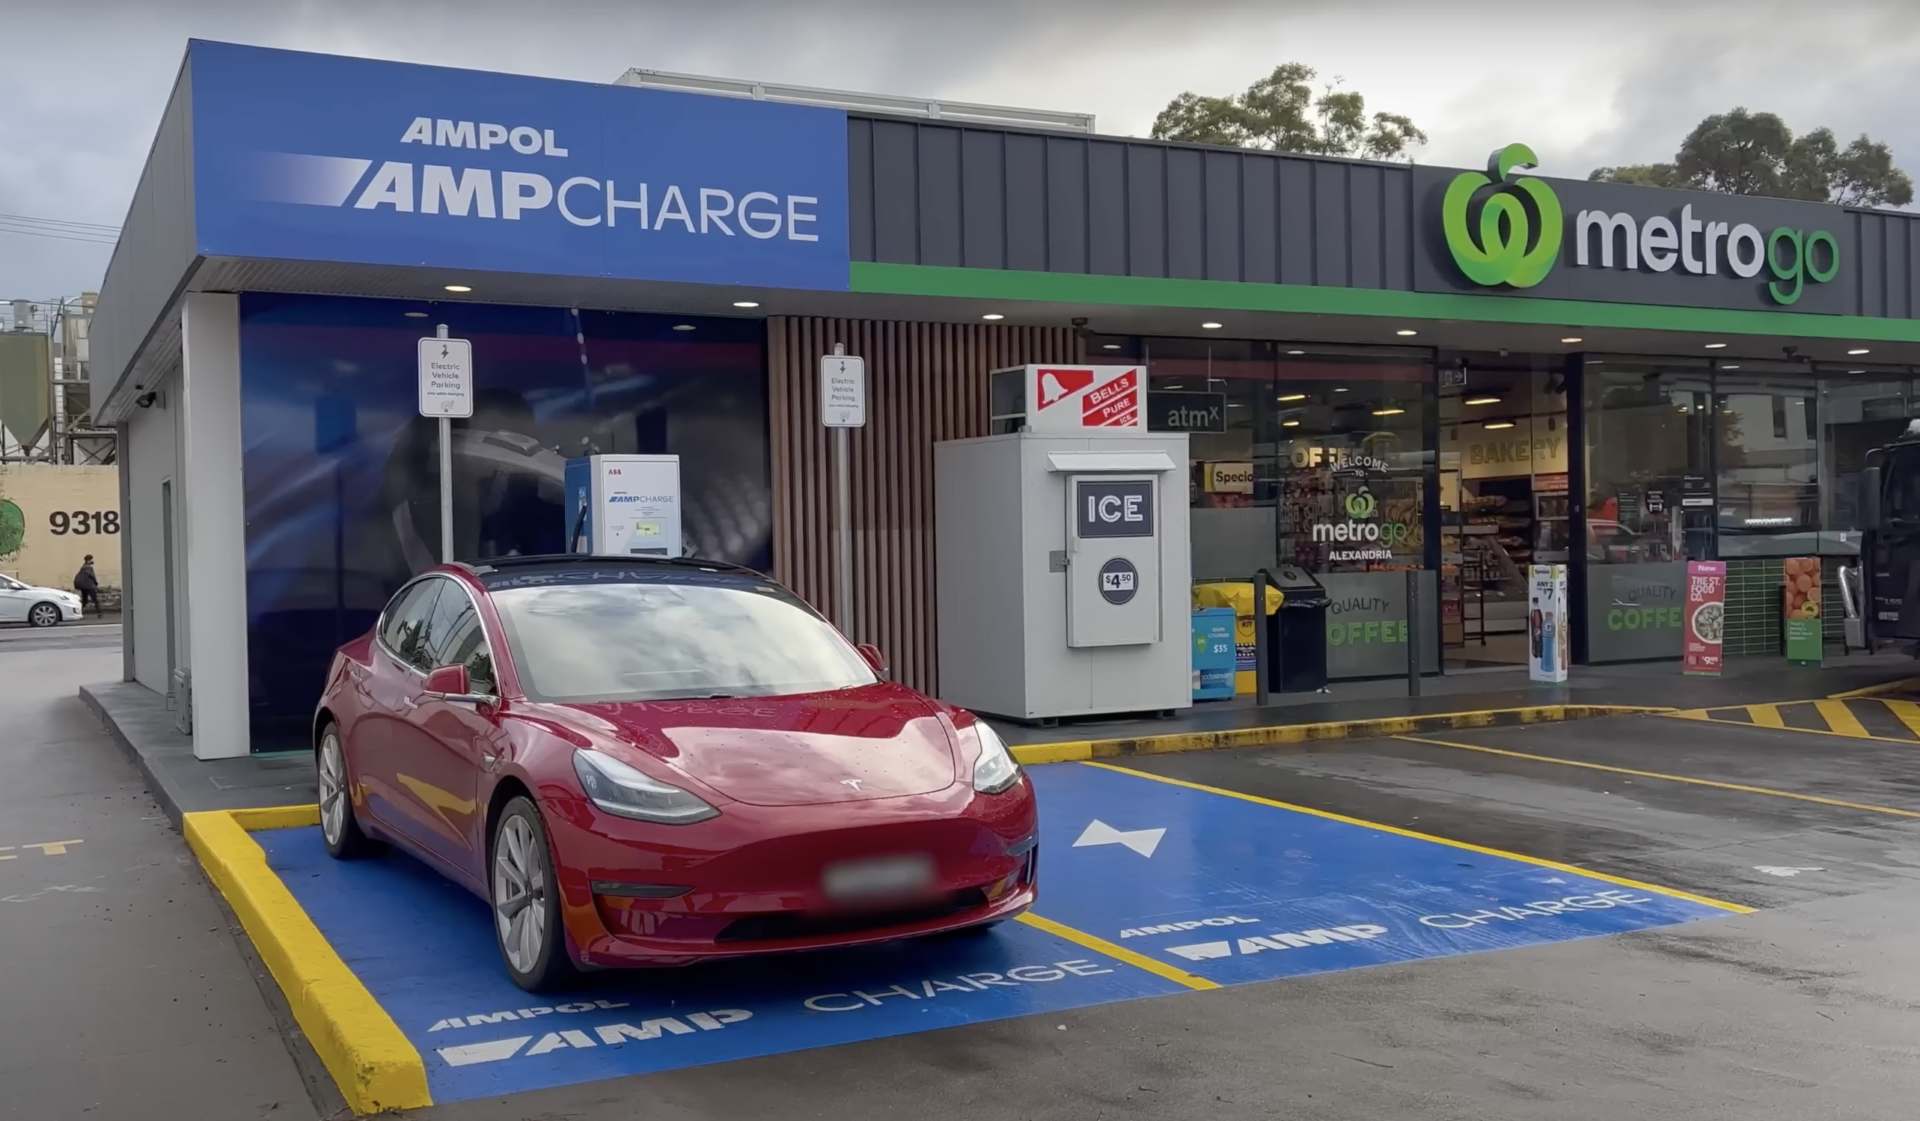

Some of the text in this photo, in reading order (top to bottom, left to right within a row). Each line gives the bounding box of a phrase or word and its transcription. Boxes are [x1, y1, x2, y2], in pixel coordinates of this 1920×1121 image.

[400, 117, 569, 157] AMPOL
[353, 160, 819, 242] AMPCHARGE
[1576, 203, 1840, 305] metrogo
[431, 362, 460, 370] Electric
[431, 381, 461, 390] Parking
[831, 394, 856, 402] Parking
[1089, 378, 1130, 405] BELLS
[1102, 397, 1131, 418] PURE
[1119, 414, 1133, 425] ICE
[1470, 437, 1560, 465] BAKERY
[1330, 456, 1389, 473] WELCOME
[1088, 494, 1143, 523] ICE
[49, 510, 121, 536] 9318
[1312, 519, 1407, 548] metrogo
[1328, 549, 1392, 561] ALEXANDRIA
[1697, 564, 1716, 572] New
[1106, 573, 1132, 589] $4.50
[1628, 585, 1676, 602] QUALITY
[1691, 584, 1715, 594] FOOD
[1331, 597, 1389, 615] QUALITY
[1213, 644, 1228, 653] $35
[1418, 890, 1653, 930] CHARGE
[1120, 915, 1260, 940] AMPOL
[1239, 924, 1390, 955] AMP
[803, 959, 1116, 1013] CHARGE
[427, 998, 631, 1032] AMPOL
[524, 1008, 754, 1056] AMP
